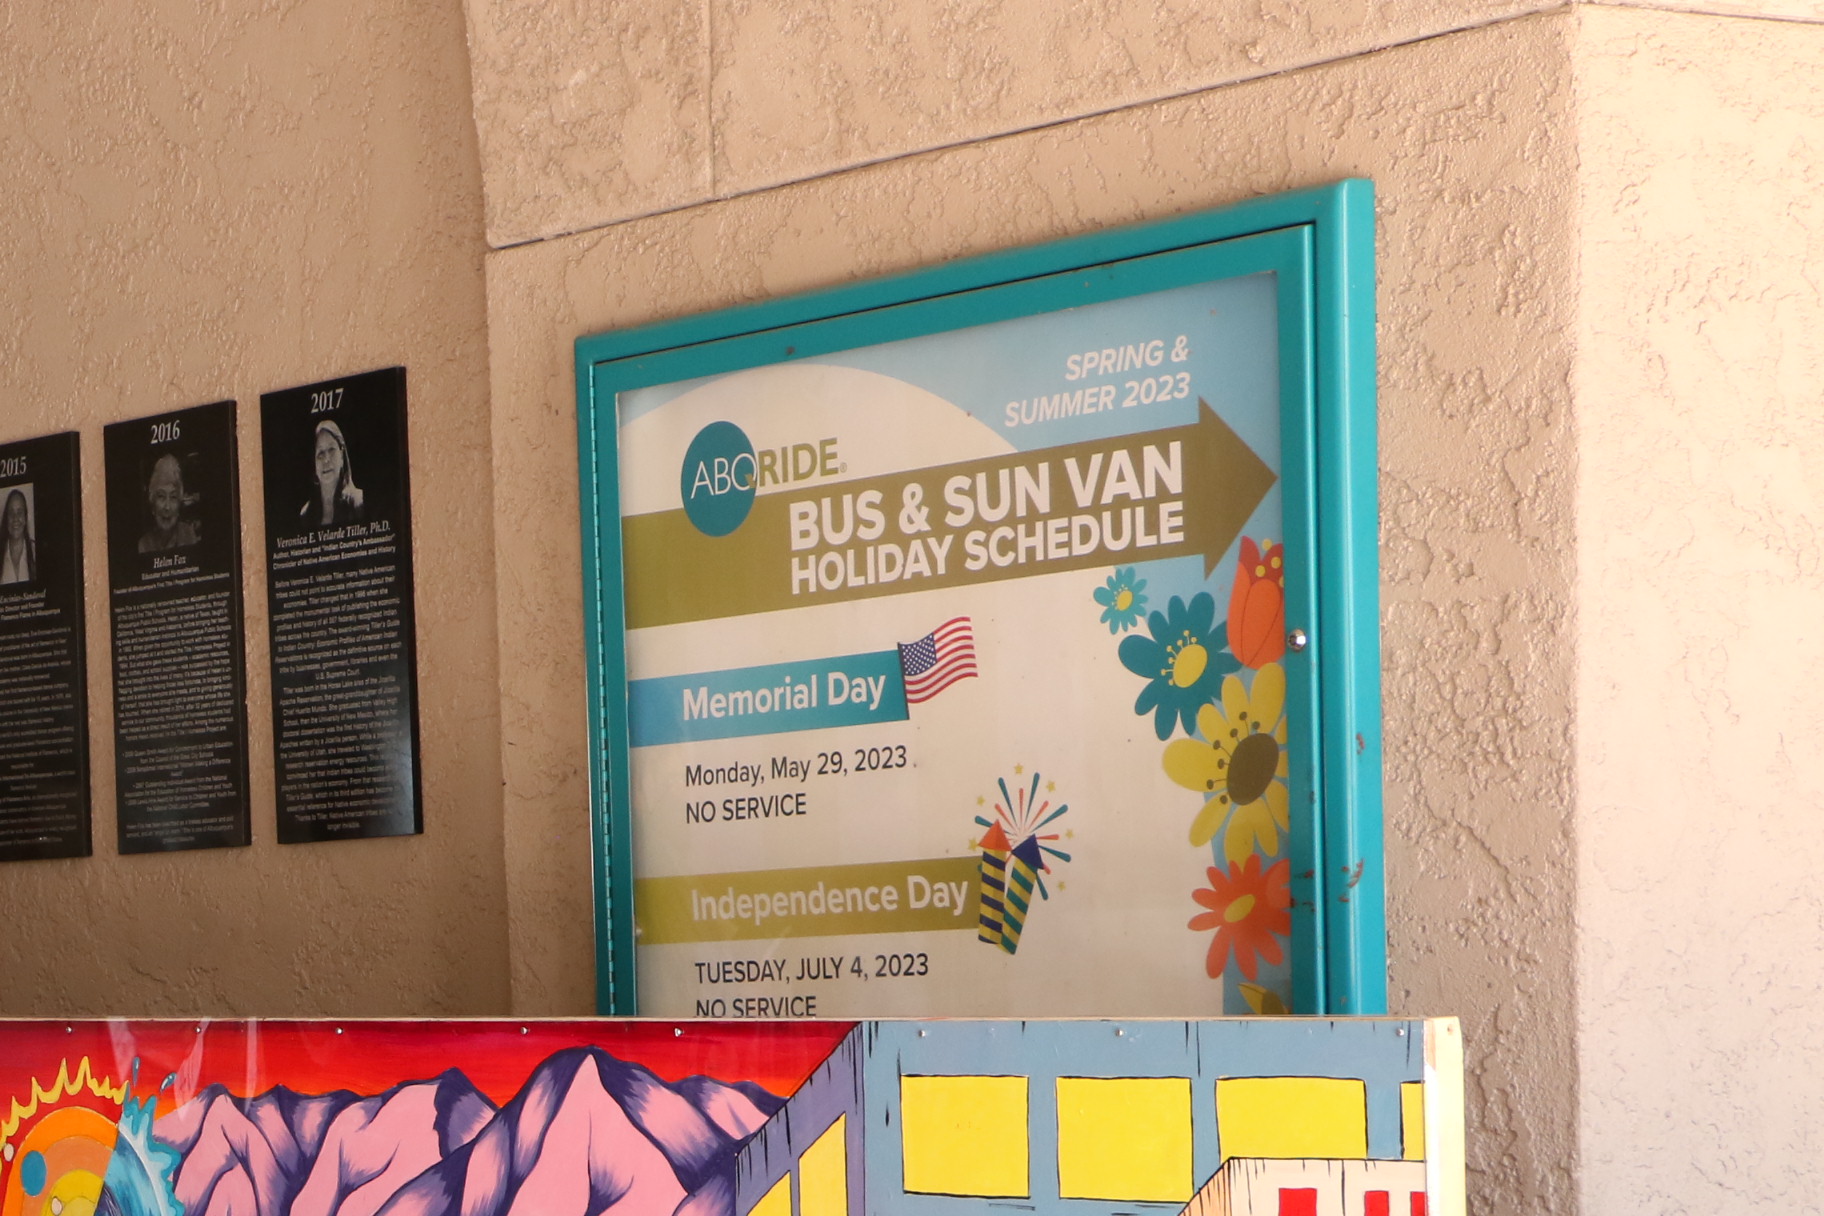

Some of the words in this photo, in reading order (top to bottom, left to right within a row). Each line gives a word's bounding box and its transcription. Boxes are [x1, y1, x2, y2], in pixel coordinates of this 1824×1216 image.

[1065, 339, 1165, 381] SPRING
[1170, 335, 1189, 362] &
[311, 388, 344, 414] 2017
[1004, 382, 1118, 429] SUMMER
[1123, 371, 1191, 410] 2023
[150, 420, 181, 445] 2016
[0, 456, 28, 478] 2015
[790, 499, 883, 551] BUS
[898, 486, 929, 535] &
[944, 470, 1051, 527] SUN
[1065, 441, 1183, 506] VAN
[277, 533, 307, 549] Veronica
[319, 528, 345, 542] Velarde
[346, 524, 368, 538] Tiller,
[370, 520, 390, 534] Ph.D.
[791, 535, 955, 596] HOLIDAY
[964, 499, 1184, 571] SCHEDULE
[154, 556, 172, 568] Helen
[174, 554, 186, 565] Fox
[682, 677, 819, 722] Memorial
[828, 670, 886, 714] Day
[685, 760, 764, 791] Monday,
[771, 755, 812, 785] May
[816, 749, 848, 778] 29,
[854, 745, 907, 771] 2023
[685, 799, 716, 824] NO
[722, 793, 807, 821] SERVICE
[691, 881, 898, 924] Independence
[907, 875, 969, 916] Day
[695, 958, 790, 987] TUESDAY,
[797, 955, 843, 982] JULY
[850, 956, 869, 980] 4,
[874, 952, 929, 979] 2023
[696, 998, 727, 1017] NO
[732, 996, 817, 1017] SERVICE
